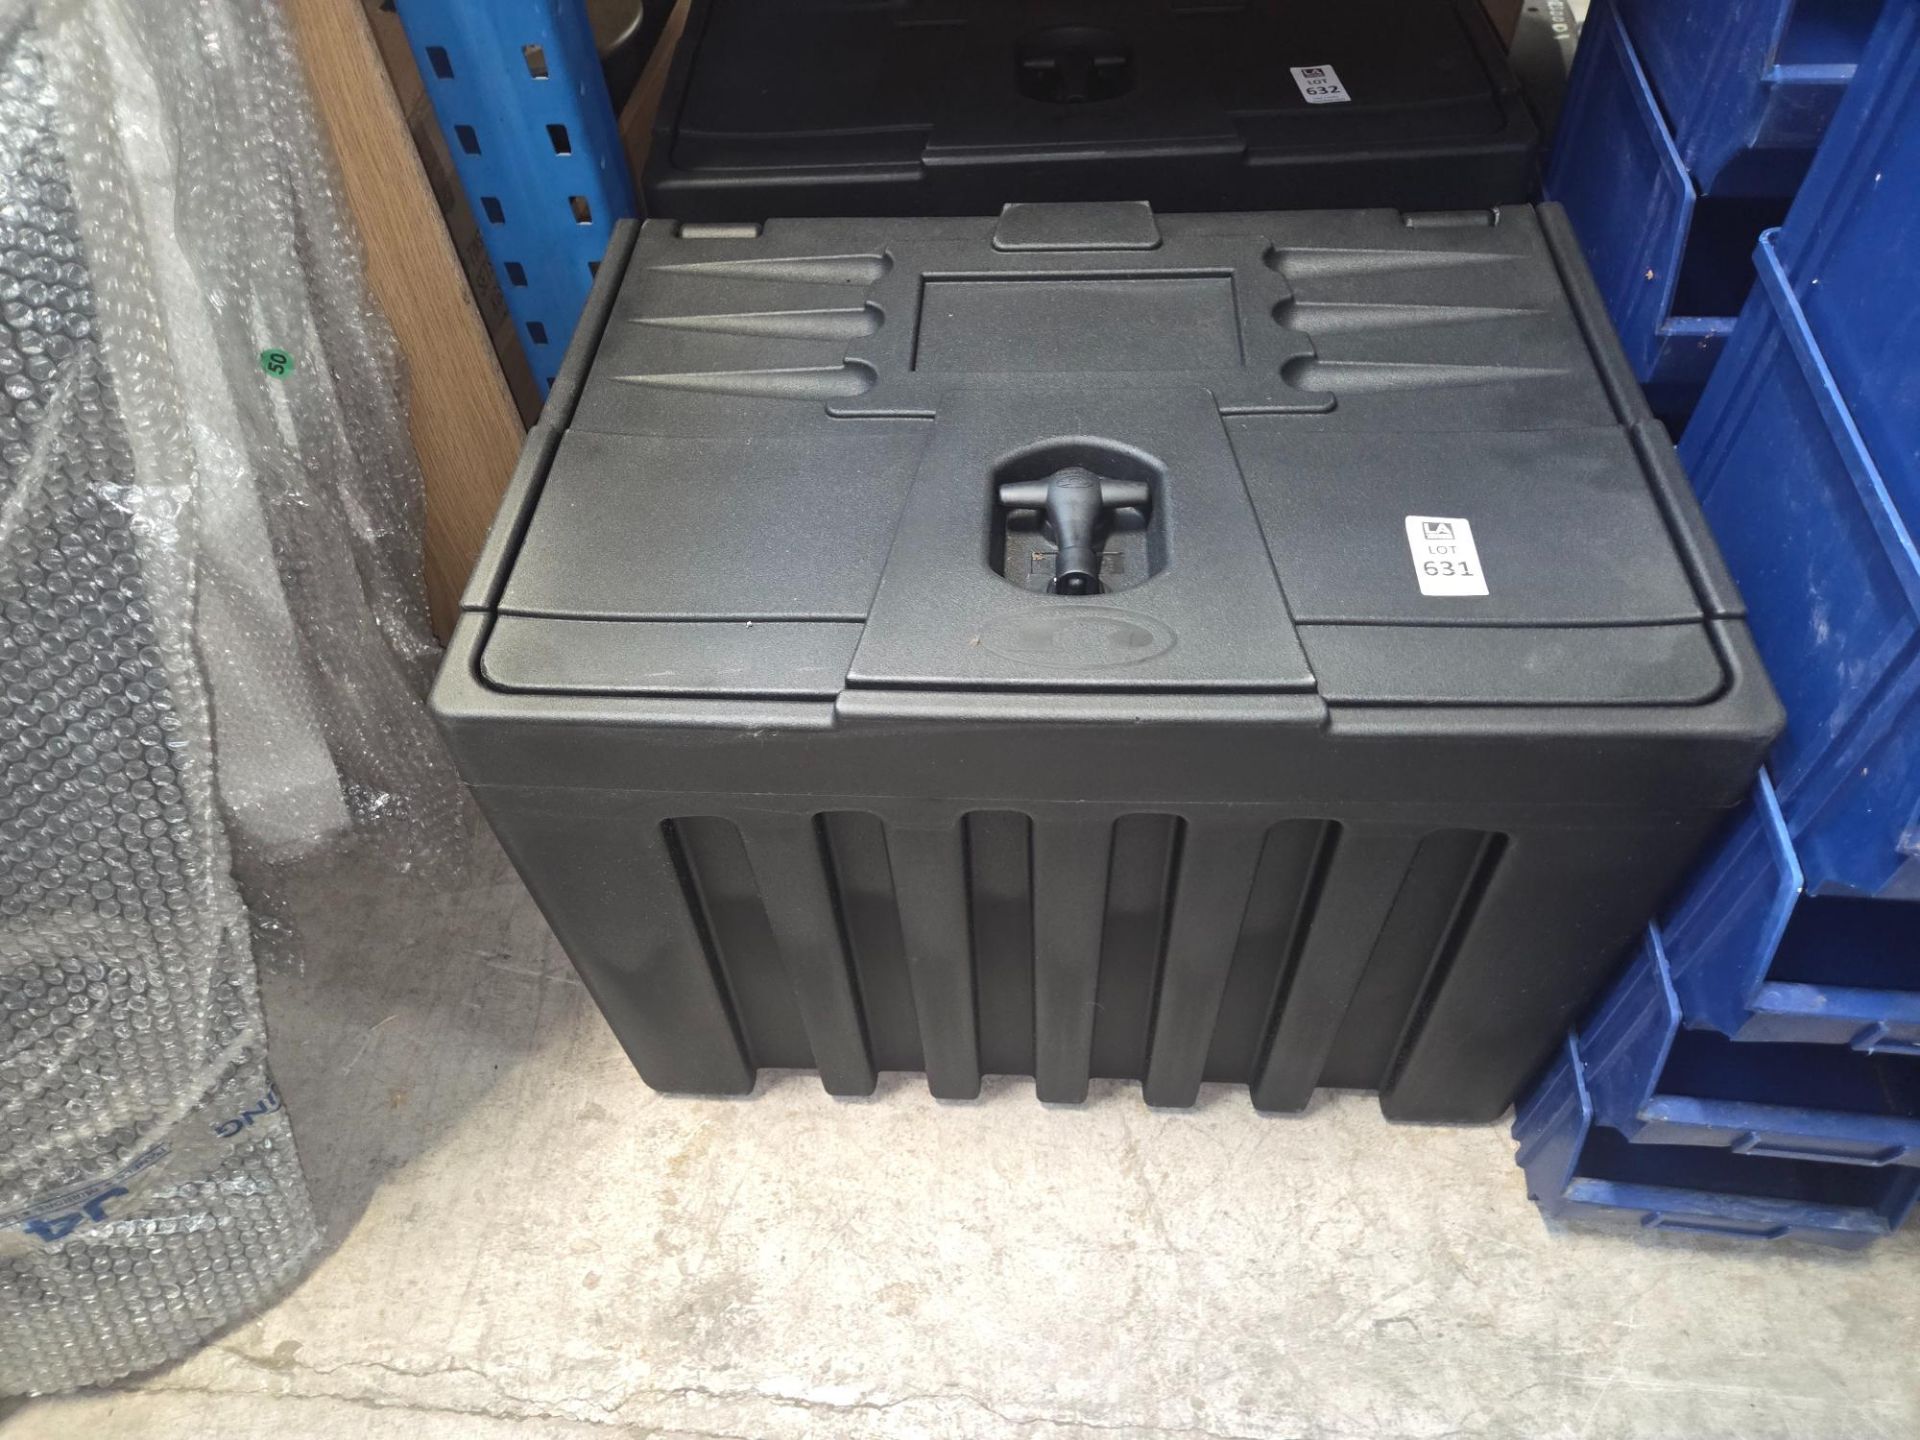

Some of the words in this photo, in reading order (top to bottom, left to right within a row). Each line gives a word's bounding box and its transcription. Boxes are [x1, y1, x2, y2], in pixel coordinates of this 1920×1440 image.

[1306, 85, 1341, 96] 632
[267, 353, 287, 375] 50
[1423, 522, 1451, 535] LA
[1428, 545, 1456, 555] LOT
[1424, 560, 1474, 576] 631
